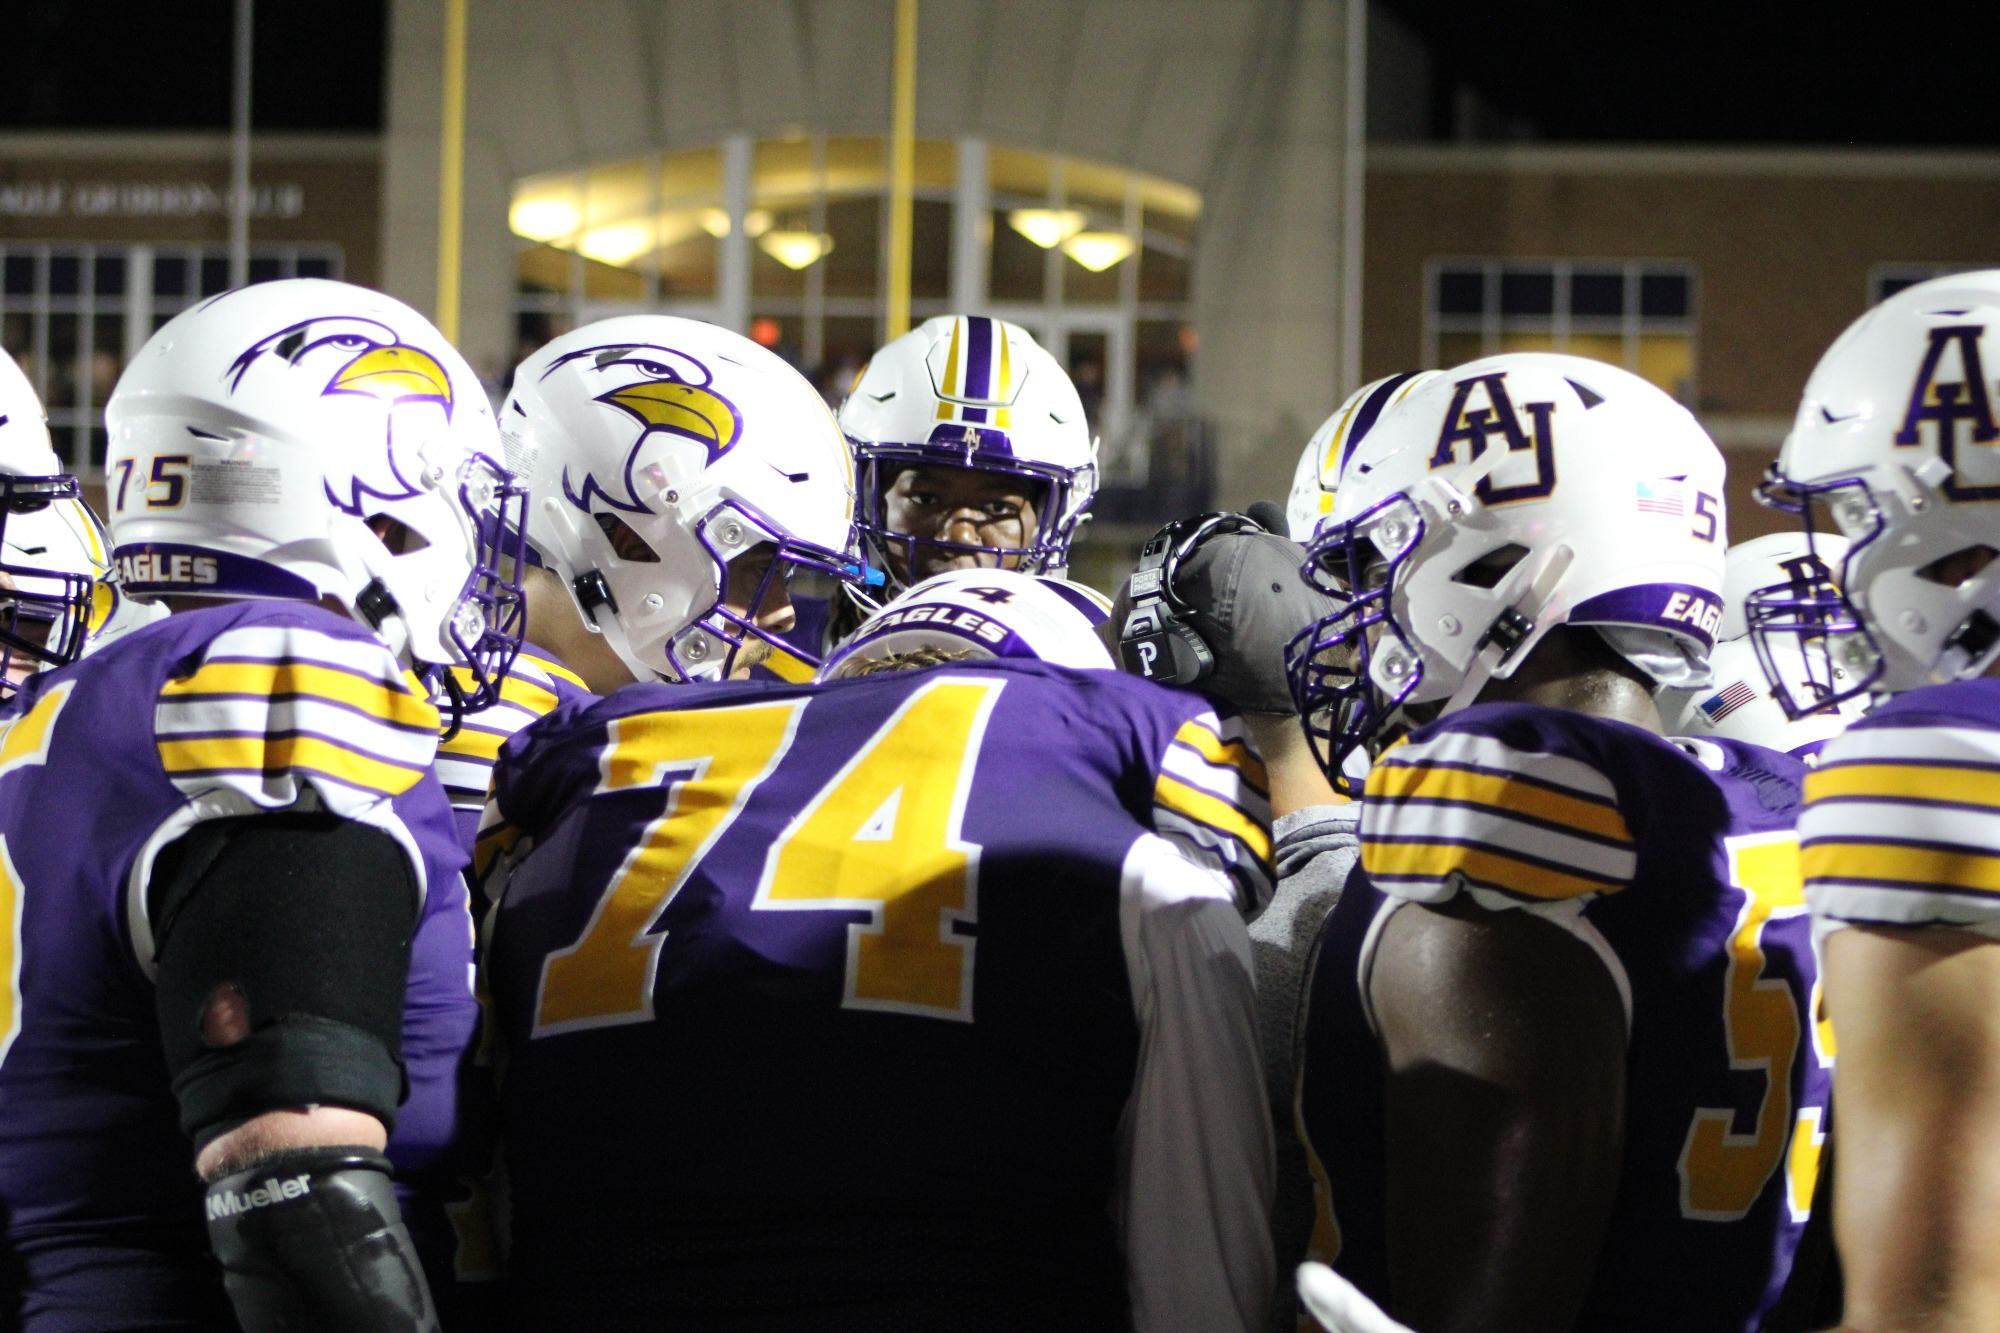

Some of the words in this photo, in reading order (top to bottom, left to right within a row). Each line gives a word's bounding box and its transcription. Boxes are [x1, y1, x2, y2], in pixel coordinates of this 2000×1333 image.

[1427, 371, 1557, 508] AU
[114, 454, 191, 514] 75
[1690, 489, 1718, 544] 5
[114, 553, 218, 585] EAGLES
[1134, 572, 1157, 584] PORTA
[854, 607, 1009, 644] EAGLES
[531, 676, 1007, 1039] 74
[205, 1174, 311, 1221] Mueller
